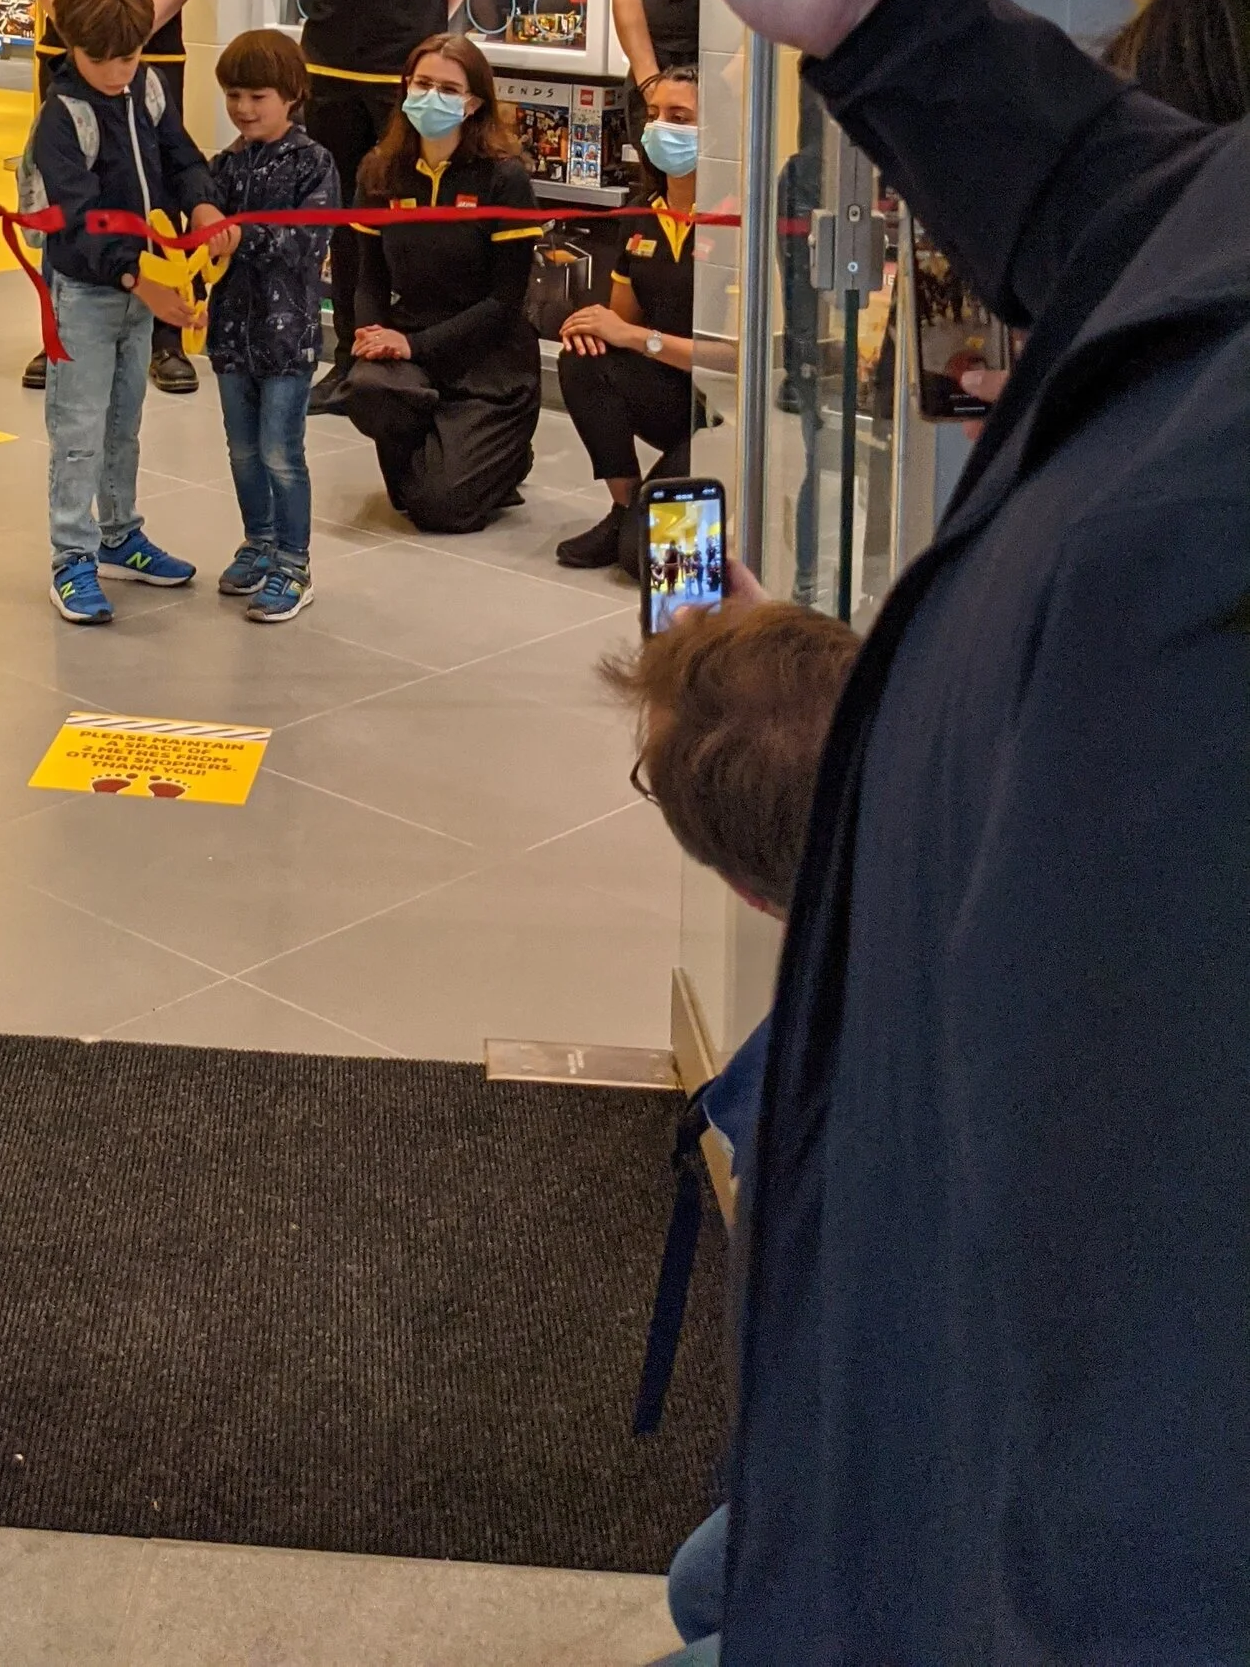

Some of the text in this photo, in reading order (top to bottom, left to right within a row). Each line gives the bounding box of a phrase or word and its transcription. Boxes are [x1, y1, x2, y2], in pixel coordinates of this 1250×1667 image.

[79, 730, 245, 751] PLEASE MAINTAIN
[124, 741, 184, 753] SPACE
[190, 747, 212, 756] OF
[66, 751, 238, 772] OTHER SHOPPERS.
[81, 744, 230, 764] 2 METRES FROM
[91, 760, 207, 777] THANK YOU!
